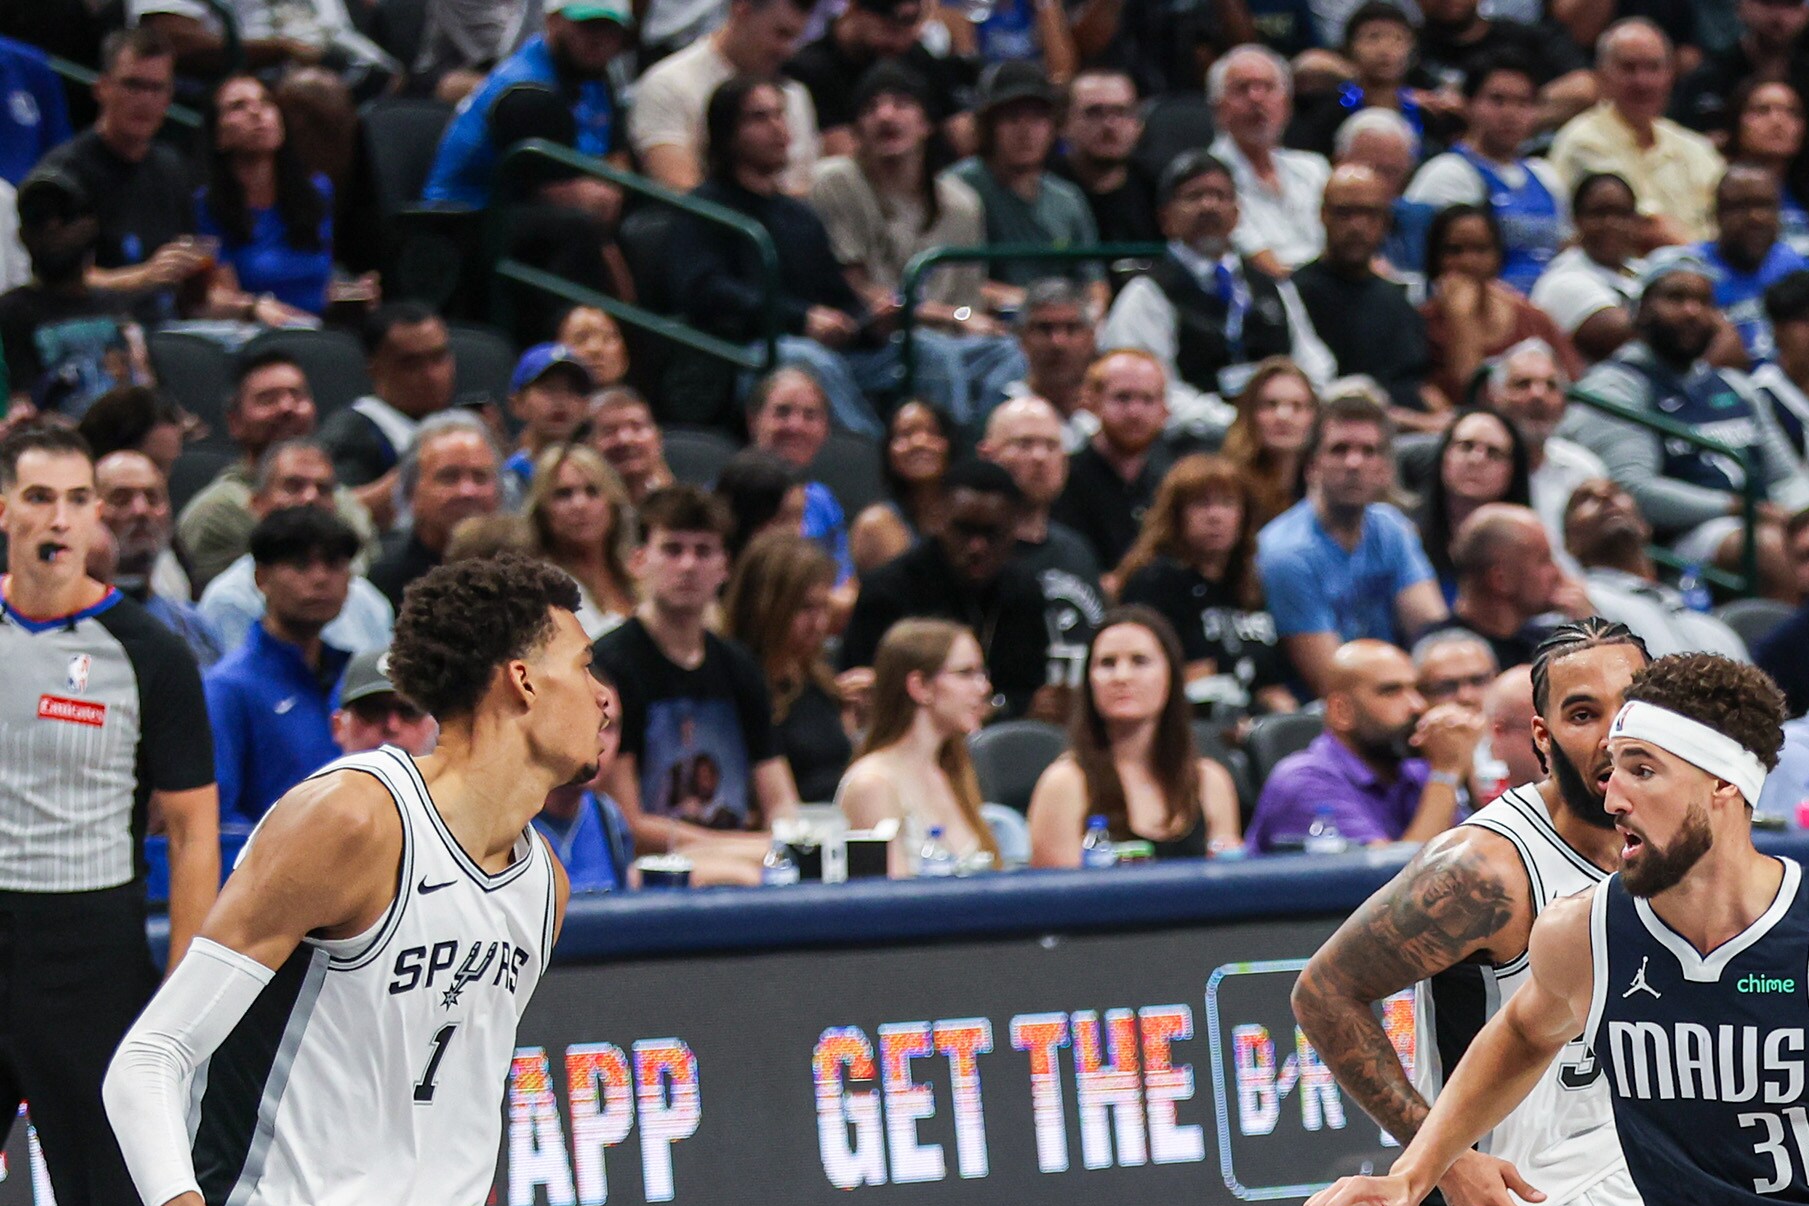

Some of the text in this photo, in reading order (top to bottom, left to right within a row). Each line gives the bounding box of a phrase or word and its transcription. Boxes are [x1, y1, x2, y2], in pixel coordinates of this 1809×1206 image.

[389, 940, 529, 1011] SPURS
[1737, 973, 1795, 994] chime
[413, 1021, 461, 1106] 1
[812, 1017, 994, 1190] GET
[1009, 1003, 1205, 1173] THE
[1608, 1021, 1804, 1104] MAVS
